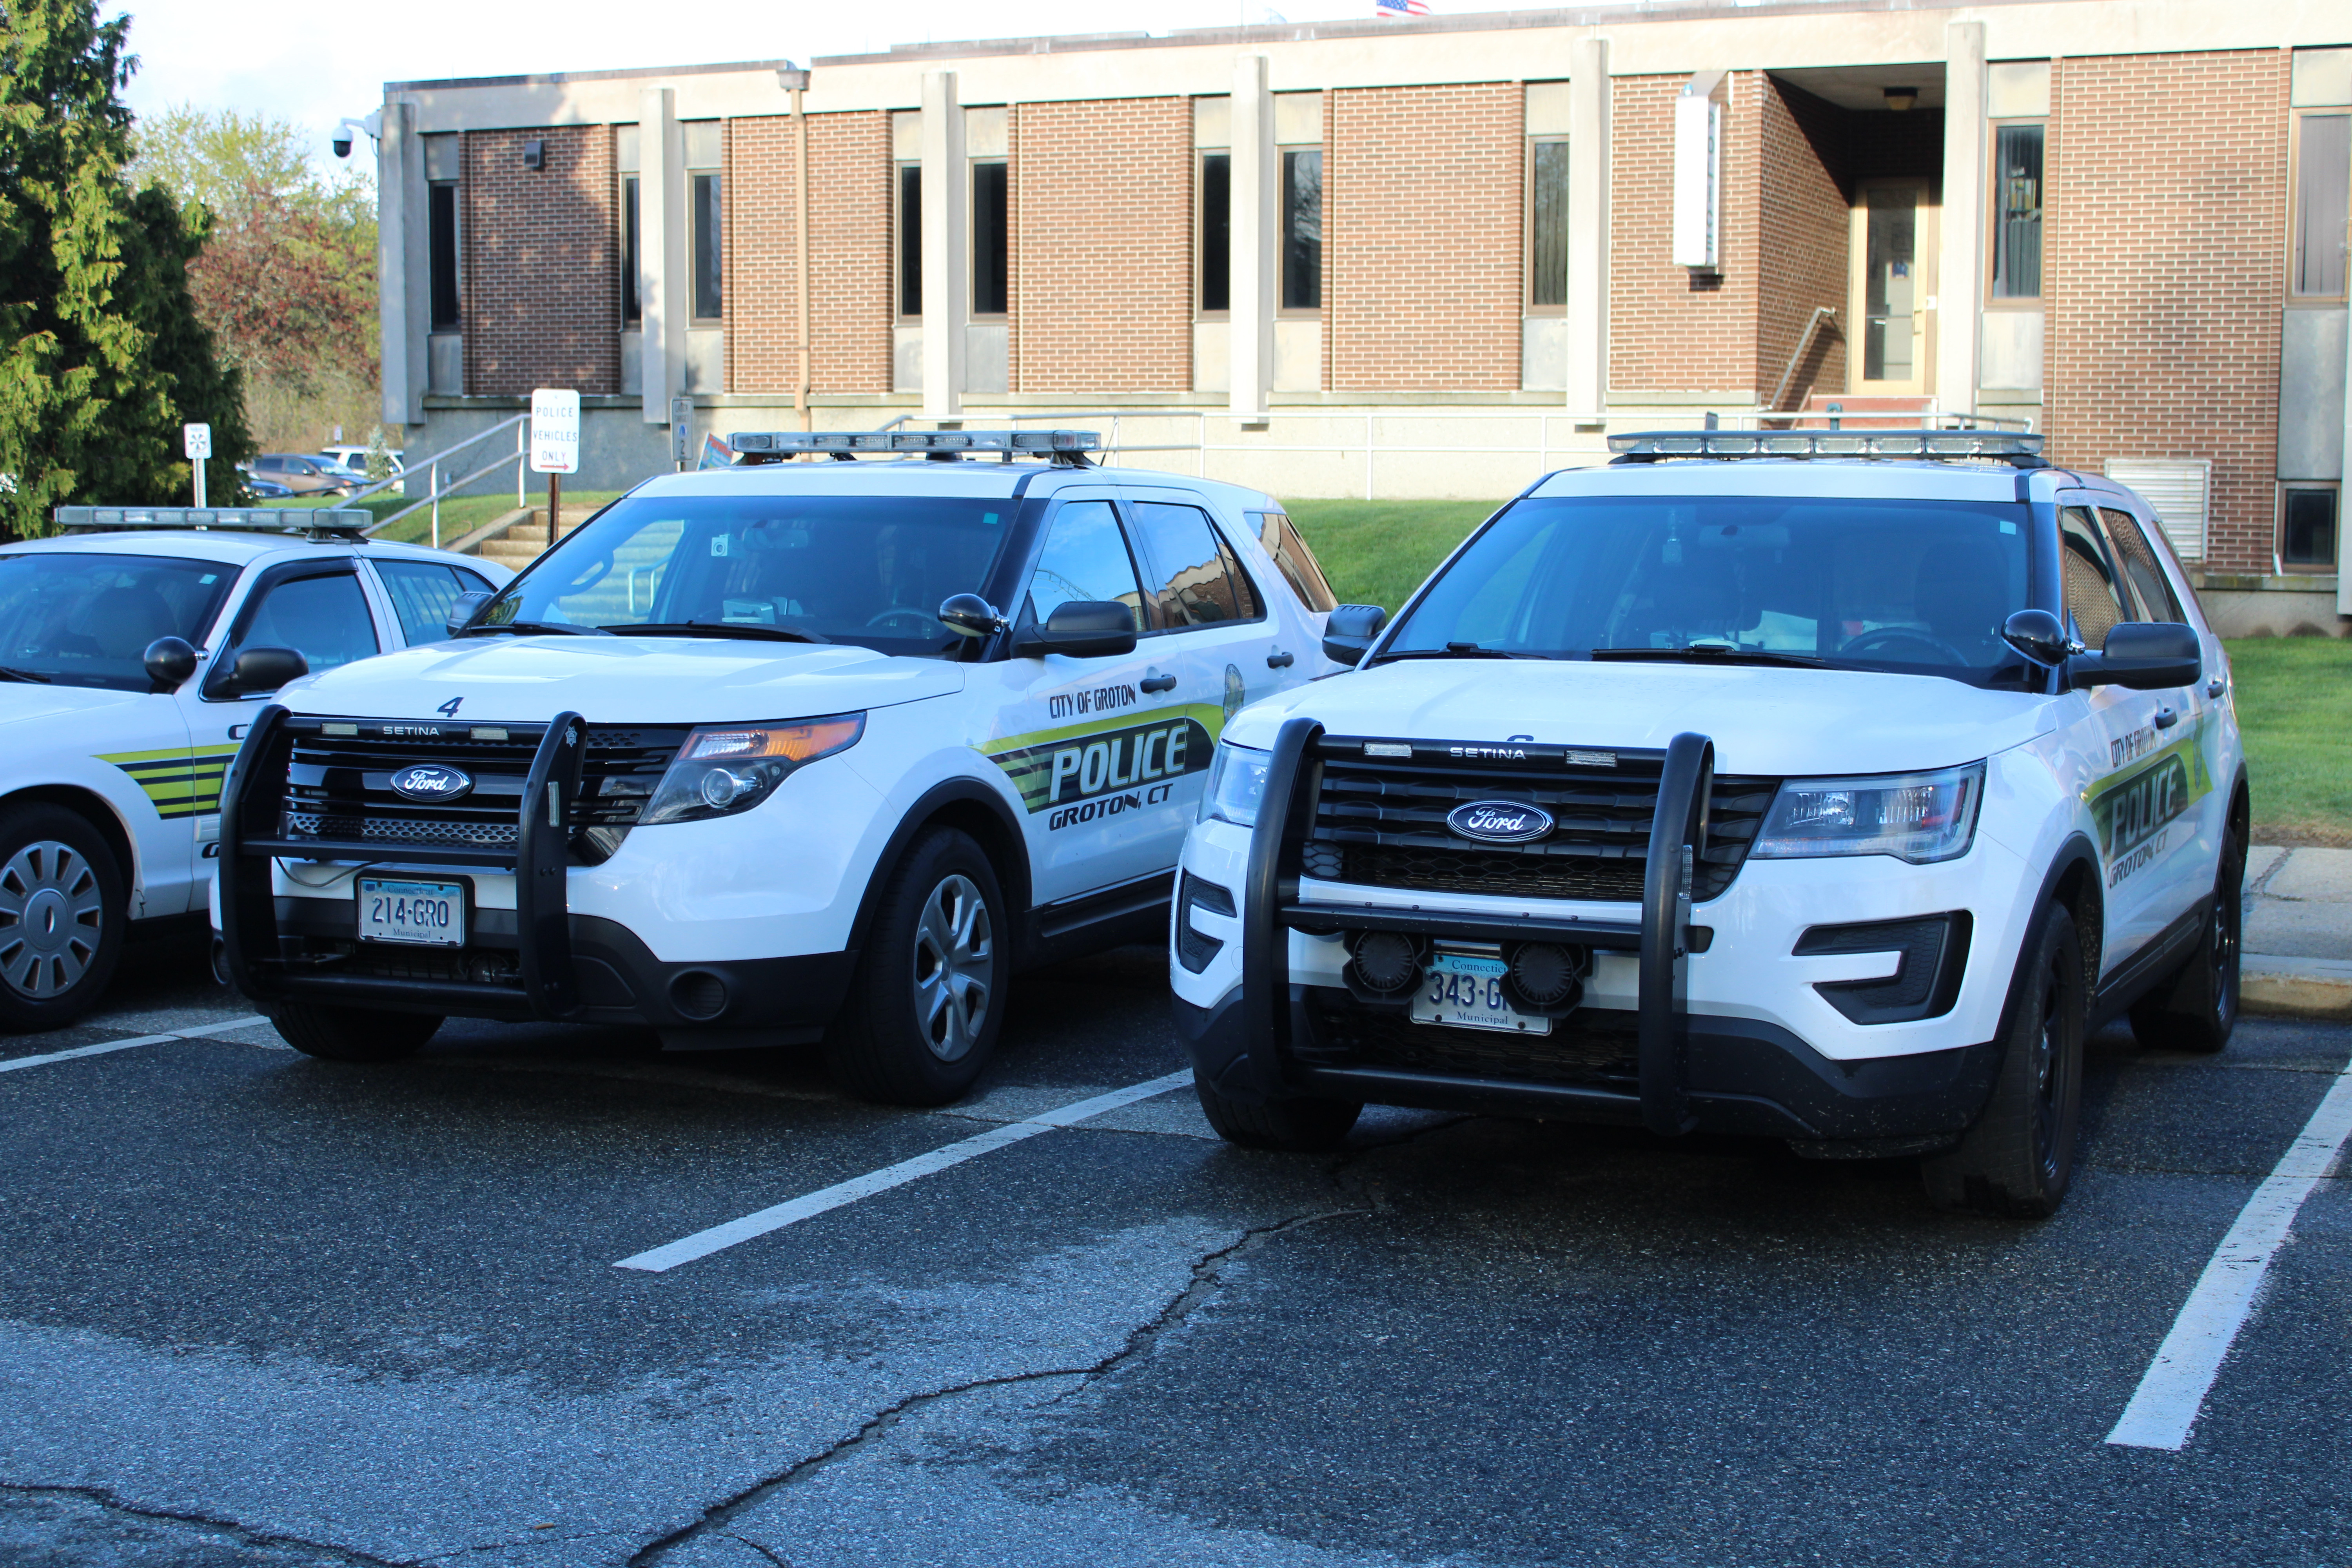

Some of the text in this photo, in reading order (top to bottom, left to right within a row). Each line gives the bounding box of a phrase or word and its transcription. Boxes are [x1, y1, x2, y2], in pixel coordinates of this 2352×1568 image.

[1706, 111, 1715, 252] POLICE
[536, 407, 573, 417] POLICE
[533, 430, 577, 442] VEHICLES
[542, 451, 566, 462] ONLY
[680, 439, 685, 455] 2
[437, 697, 465, 717] 4
[1049, 683, 1136, 719] CITY OF GROTON
[383, 726, 439, 736] SETINA
[1450, 747, 1526, 760] SETINA
[2111, 737, 2125, 768] CITY
[2125, 733, 2133, 761] OF
[1049, 724, 1189, 803] POLICE
[405, 770, 449, 791] Ford
[1049, 783, 1173, 831] GROTON, CT
[2111, 761, 2178, 856] POLICE
[1468, 807, 1526, 831] Ford
[2156, 829, 2169, 855] CT
[388, 885, 434, 895] Connecticut
[393, 928, 430, 938] Municipal
[1457, 1011, 1508, 1025] Municipal
